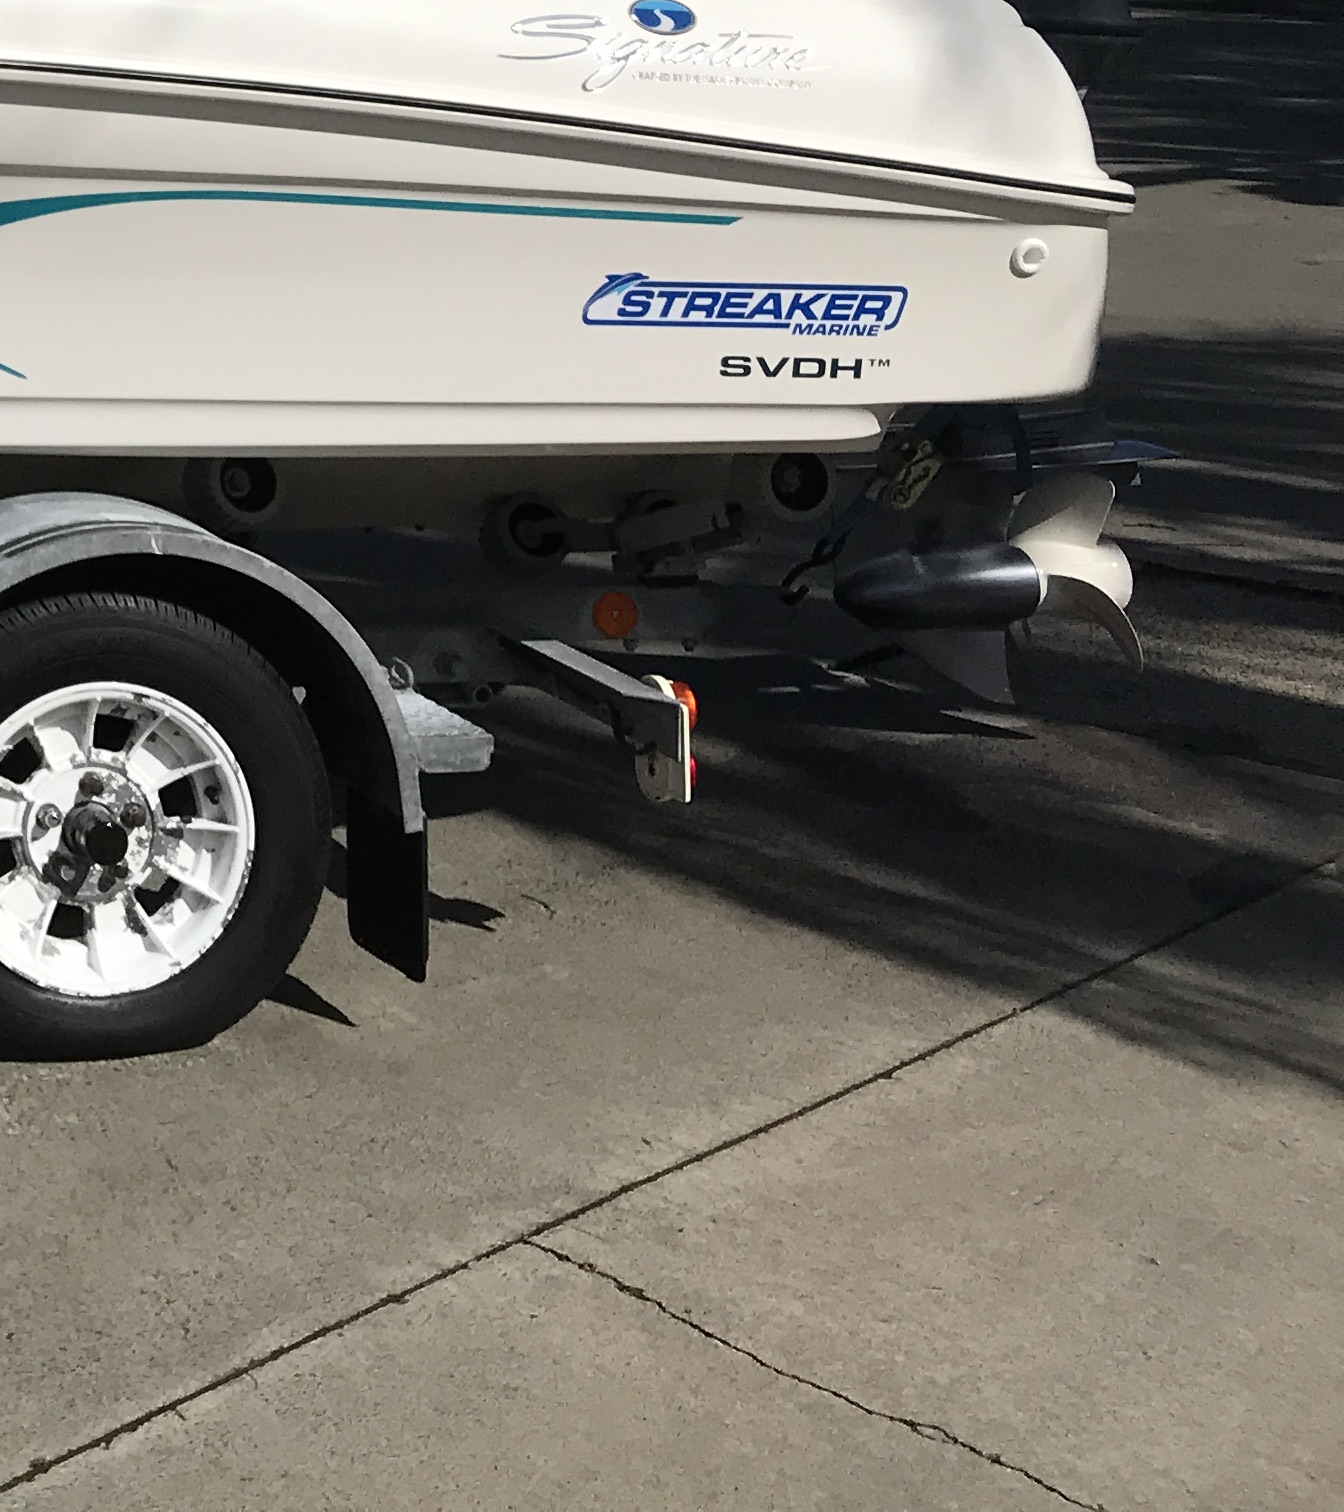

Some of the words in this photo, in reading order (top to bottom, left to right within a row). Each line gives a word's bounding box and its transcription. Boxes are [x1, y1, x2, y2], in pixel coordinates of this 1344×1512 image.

[497, 14, 834, 92] Signature
[616, 289, 893, 324] STREAKER
[791, 323, 881, 337] MARINE
